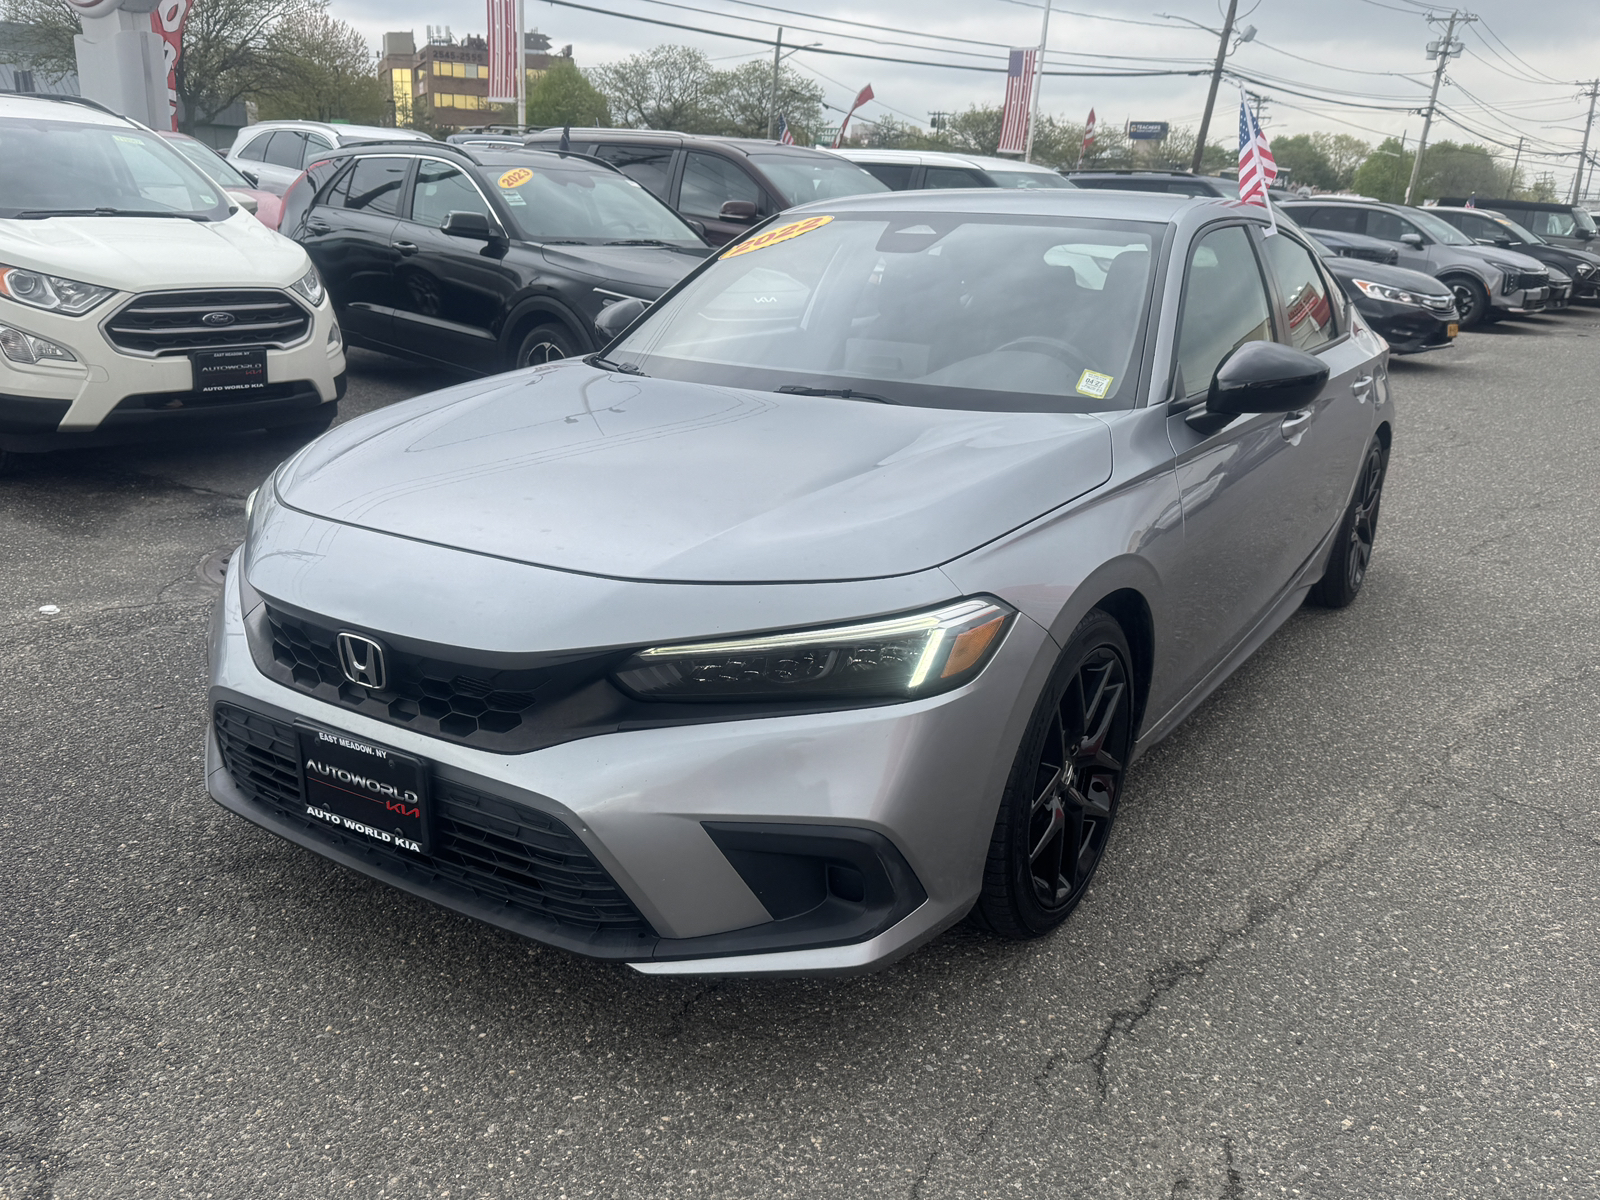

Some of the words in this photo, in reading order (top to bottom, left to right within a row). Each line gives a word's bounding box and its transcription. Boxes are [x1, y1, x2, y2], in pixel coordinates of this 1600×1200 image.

[502, 169, 531, 187] 2023
[729, 217, 824, 257] 2022
[201, 363, 262, 372] AUTOWORLD
[318, 732, 338, 745] EAST
[375, 748, 387, 759] NY
[306, 758, 418, 804] AUTOWORLD
[385, 800, 421, 818] KIA
[306, 806, 341, 825] AUTO
[343, 818, 391, 842] WORLD
[394, 837, 421, 853] KIA
